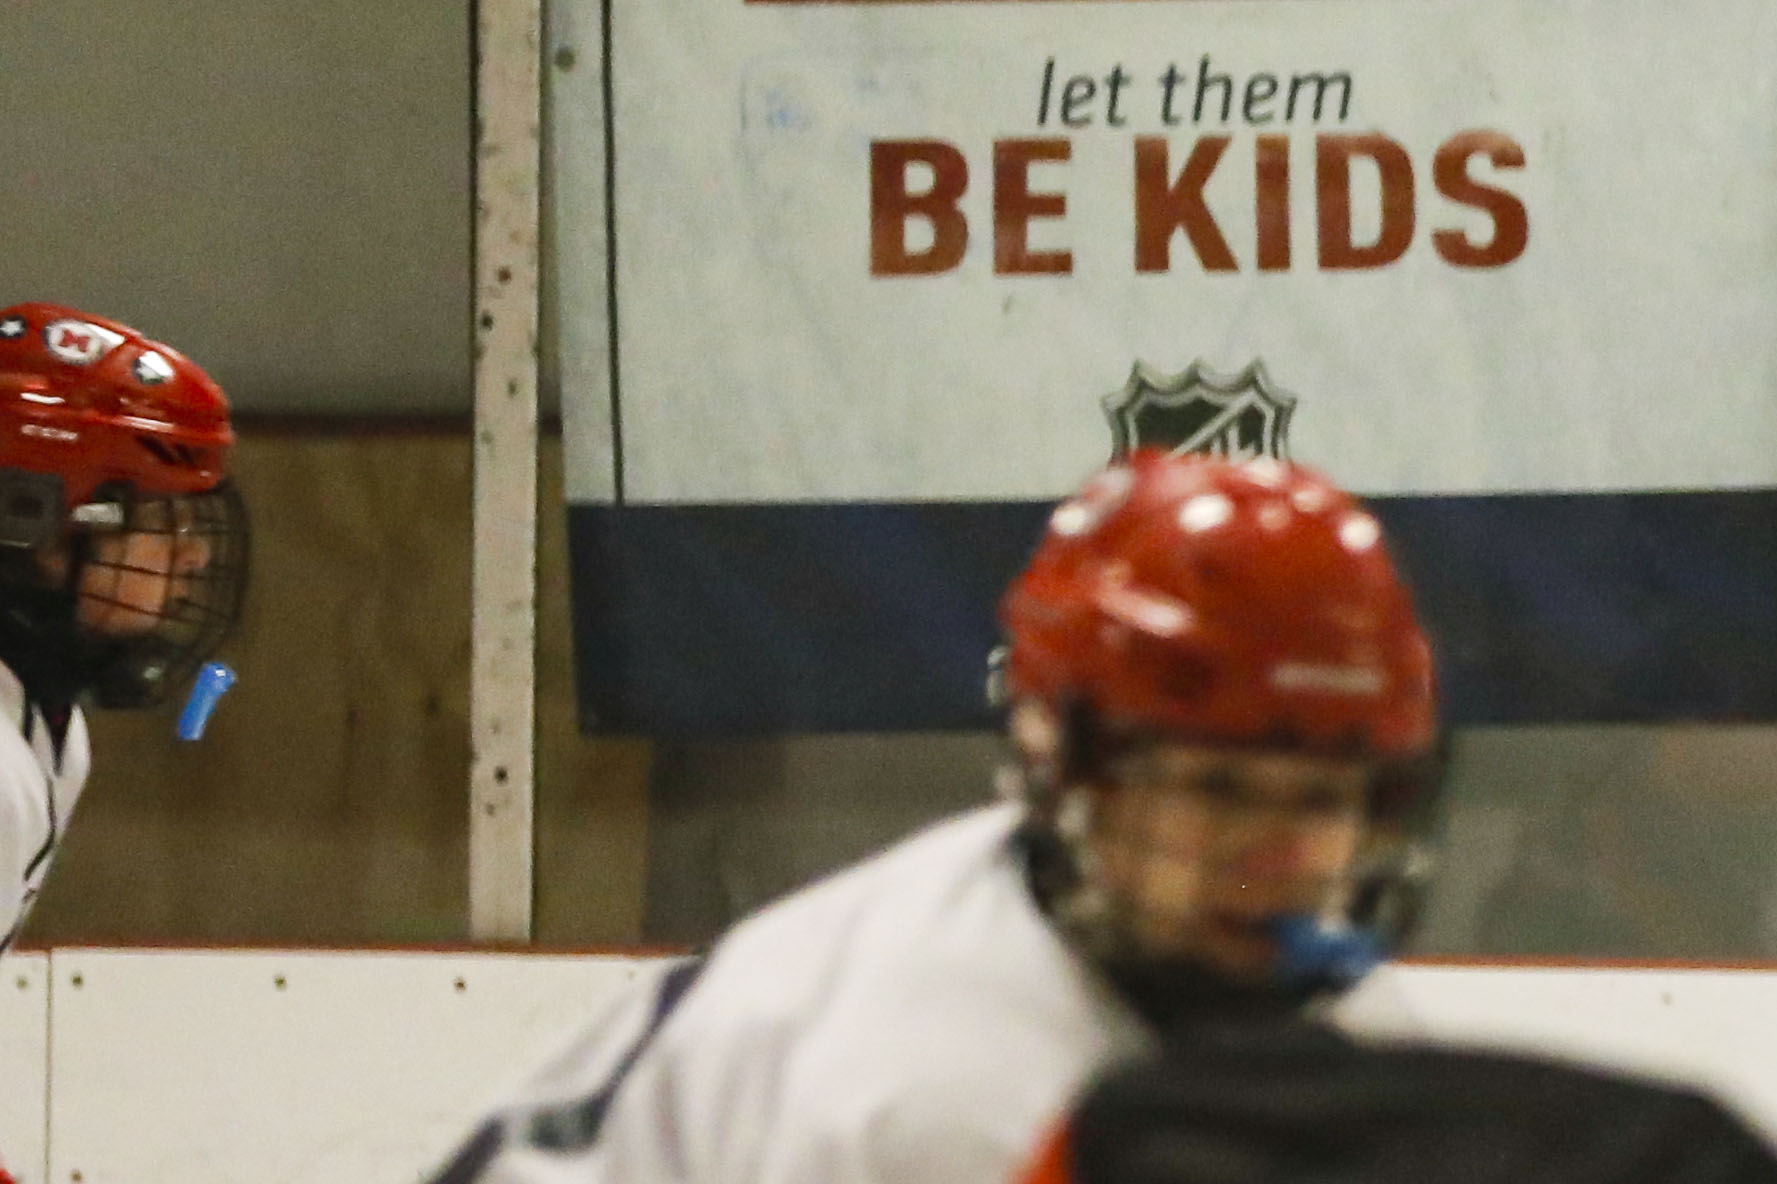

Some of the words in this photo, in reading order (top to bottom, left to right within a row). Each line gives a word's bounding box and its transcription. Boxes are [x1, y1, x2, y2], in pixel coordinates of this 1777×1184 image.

[1037, 56, 1132, 127] let
[1158, 54, 1352, 126] them
[869, 137, 1074, 278] BE
[1134, 130, 1530, 273] KIDS
